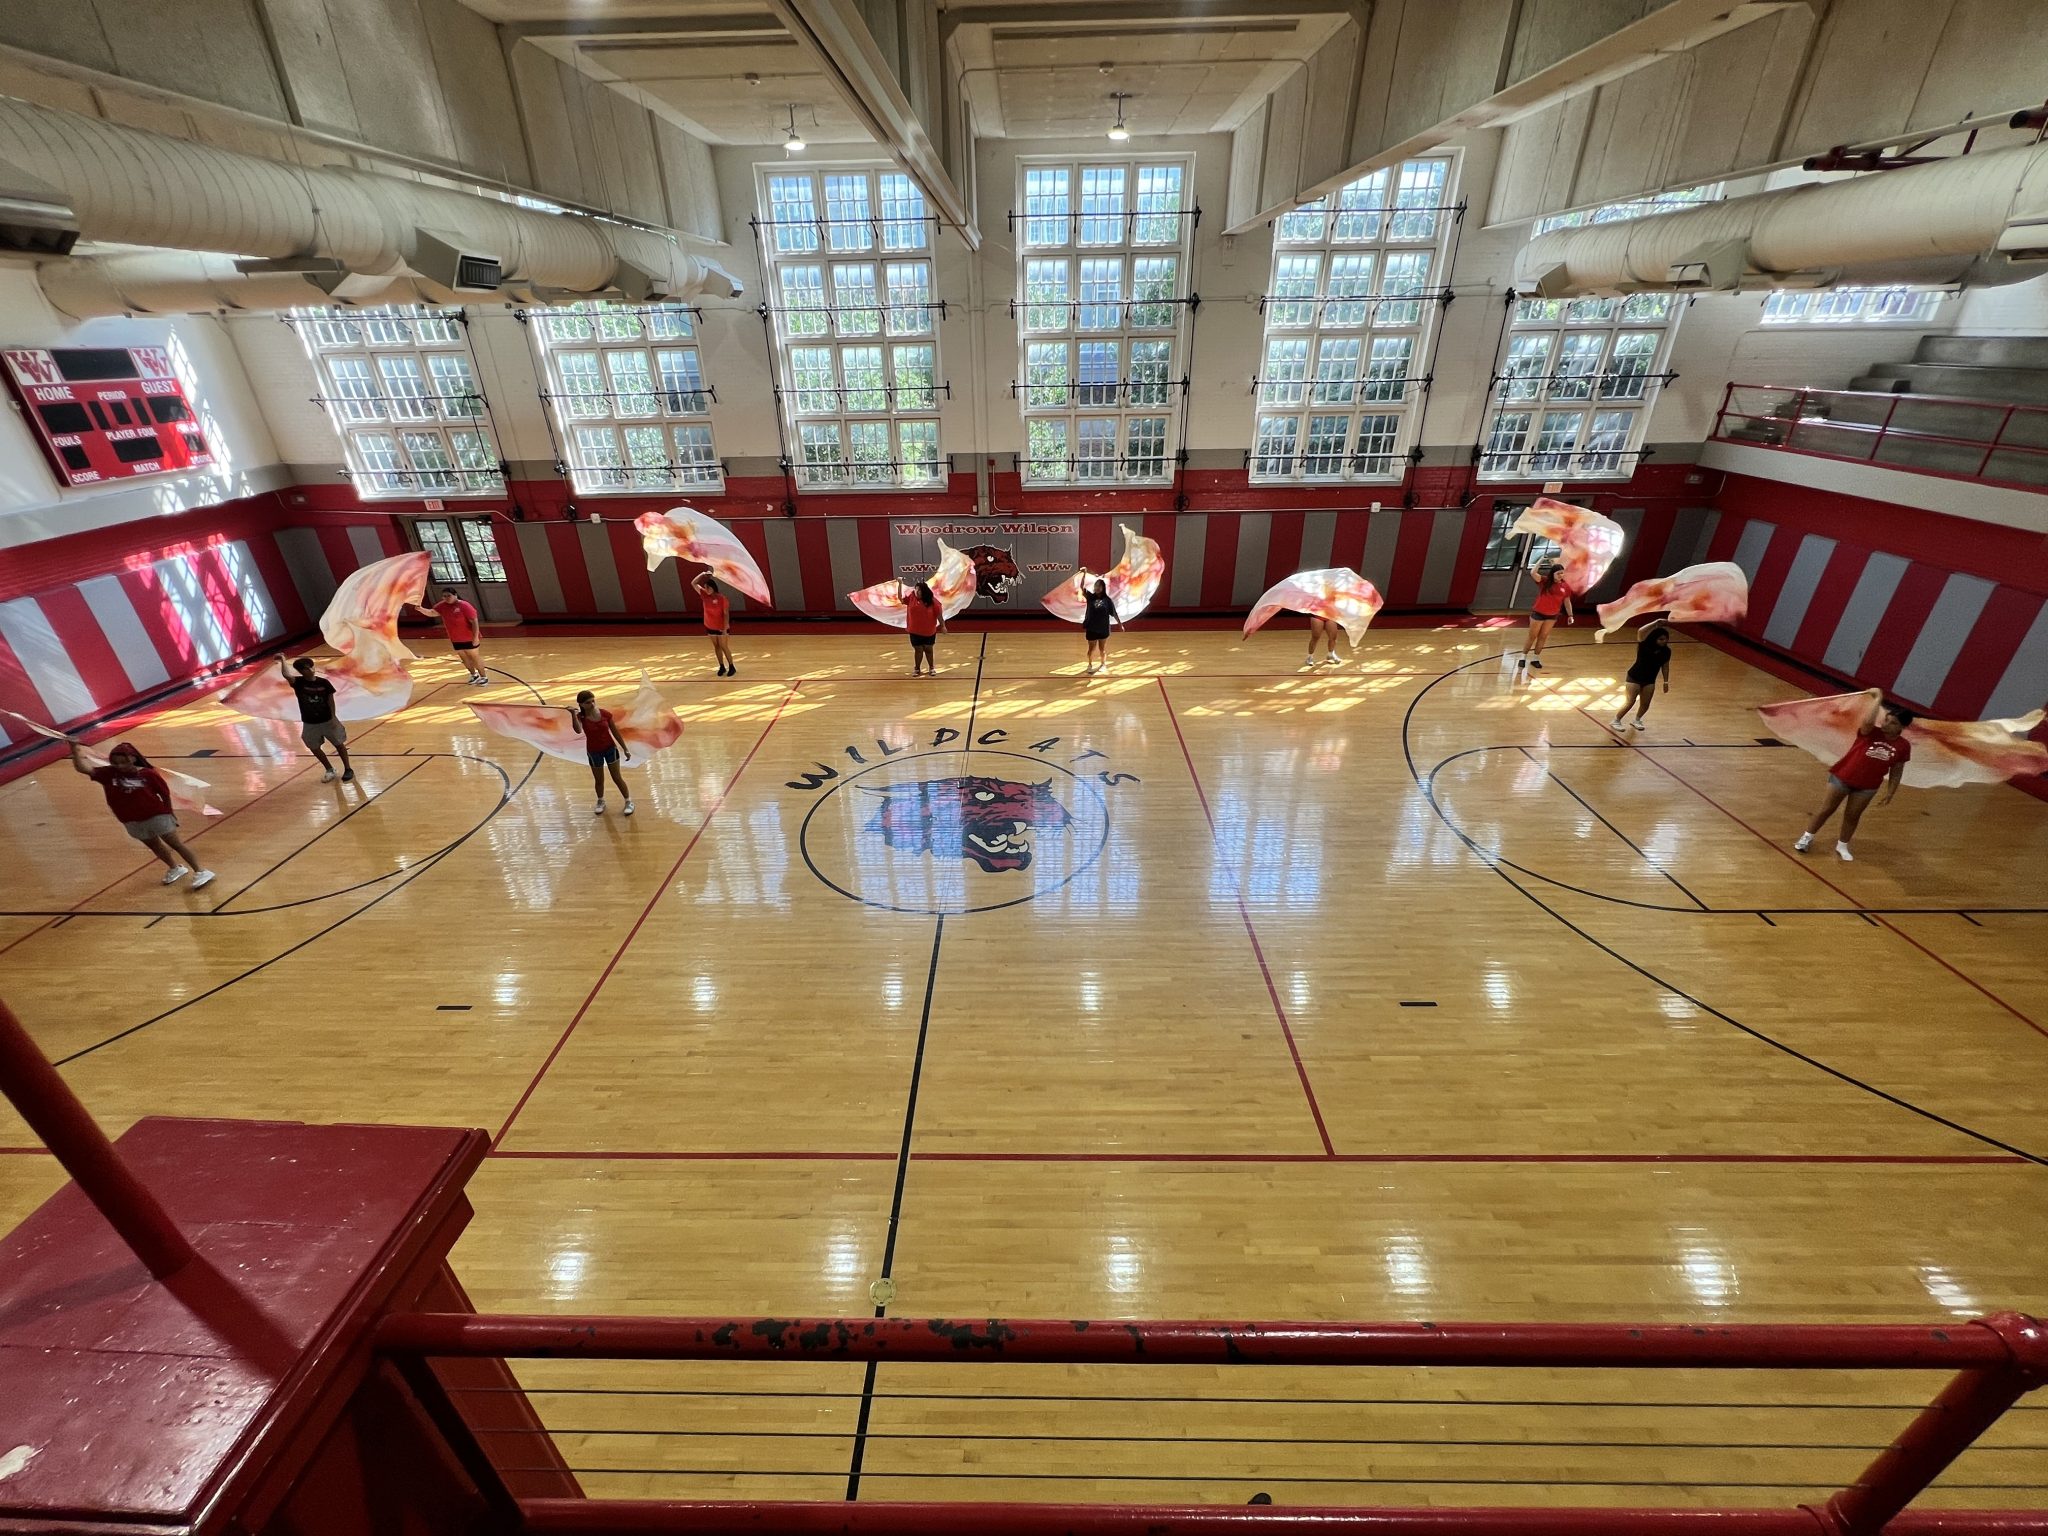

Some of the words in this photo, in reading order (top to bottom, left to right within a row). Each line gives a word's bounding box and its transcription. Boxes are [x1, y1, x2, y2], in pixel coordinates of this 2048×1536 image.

[33, 386, 76, 400] HOME
[141, 381, 176, 394] GUEST
[97, 391, 127, 400] PERIOD
[105, 429, 136, 440] PLAYER
[136, 427, 158, 438] FOUL
[52, 435, 82, 447] FOULS
[133, 462, 160, 473] MATCH
[72, 471, 101, 483] SCORE
[895, 523, 997, 535] Woodrow
[999, 522, 1075, 535] Wilson
[785, 727, 1141, 790] WILDCATS
